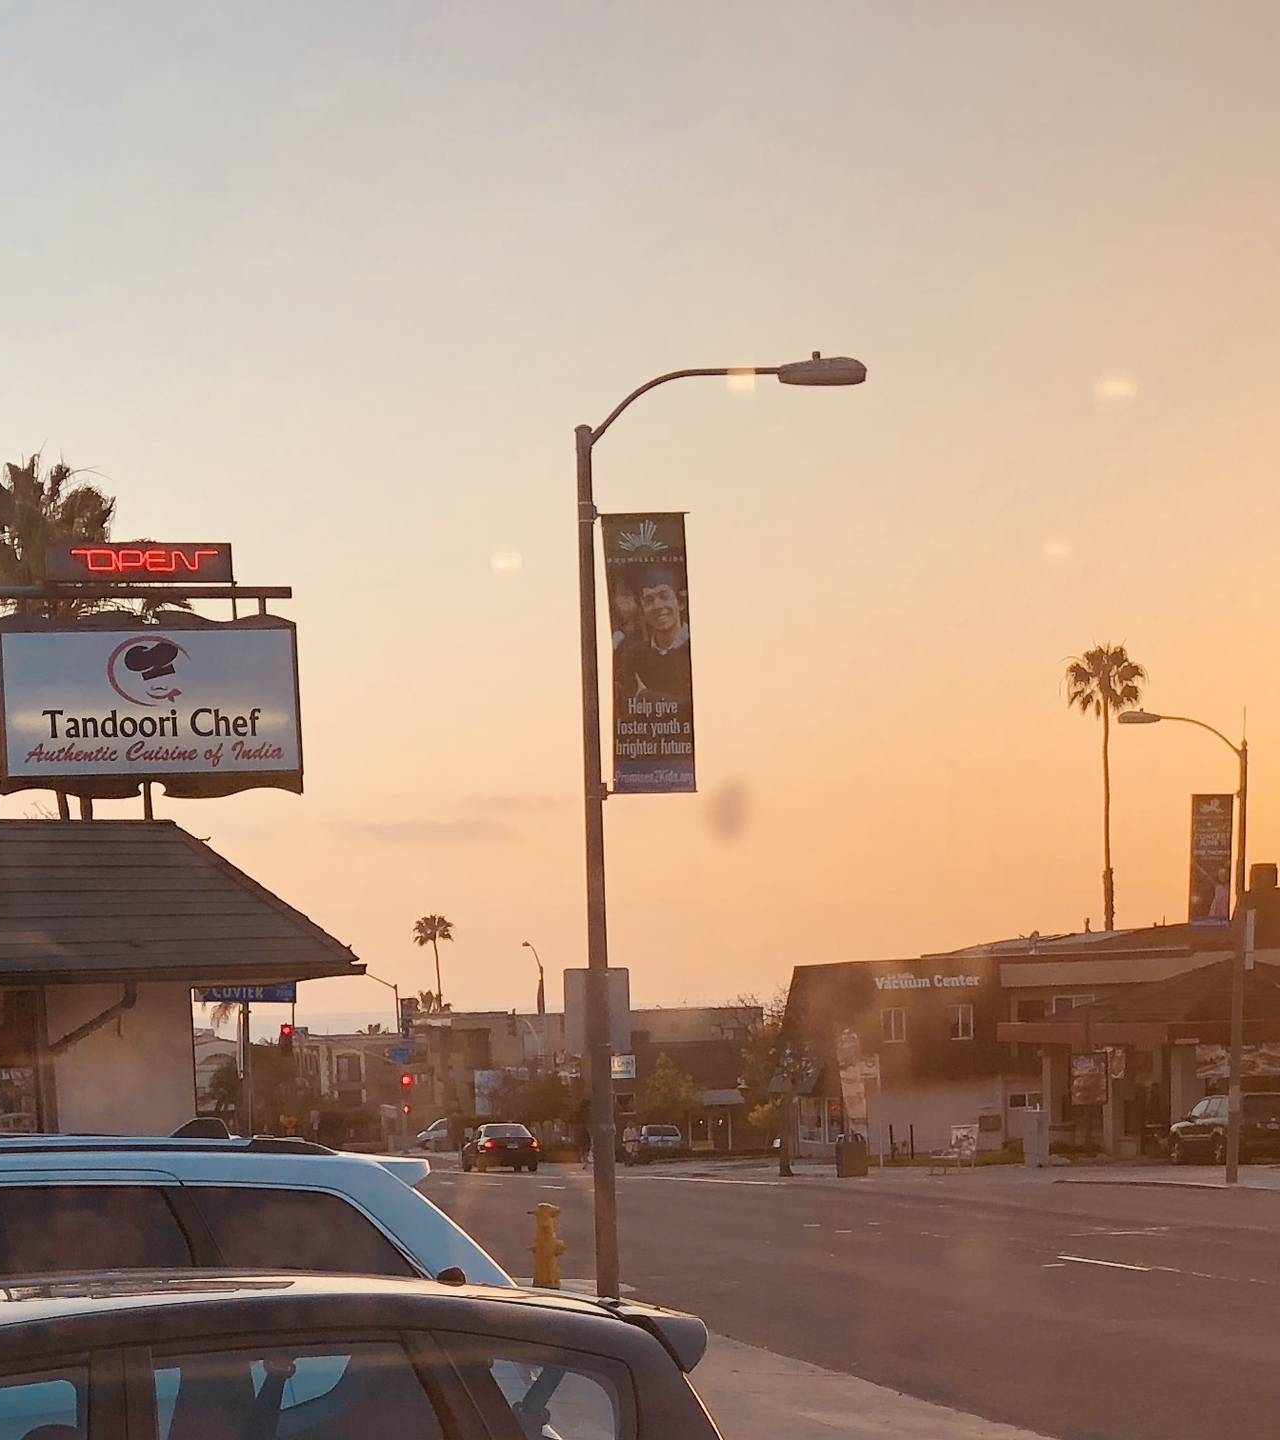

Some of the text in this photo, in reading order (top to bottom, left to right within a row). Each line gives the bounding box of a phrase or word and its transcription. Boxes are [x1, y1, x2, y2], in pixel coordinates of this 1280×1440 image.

[71, 548, 218, 572] OPEN
[628, 698, 678, 717] Help give
[42, 708, 261, 738] Tandoori Chef
[617, 718, 690, 737] foster youth a
[24, 741, 284, 767] Authentic Cuisine of India
[616, 738, 692, 758] brighter future
[875, 974, 980, 990] Vacuum Center
